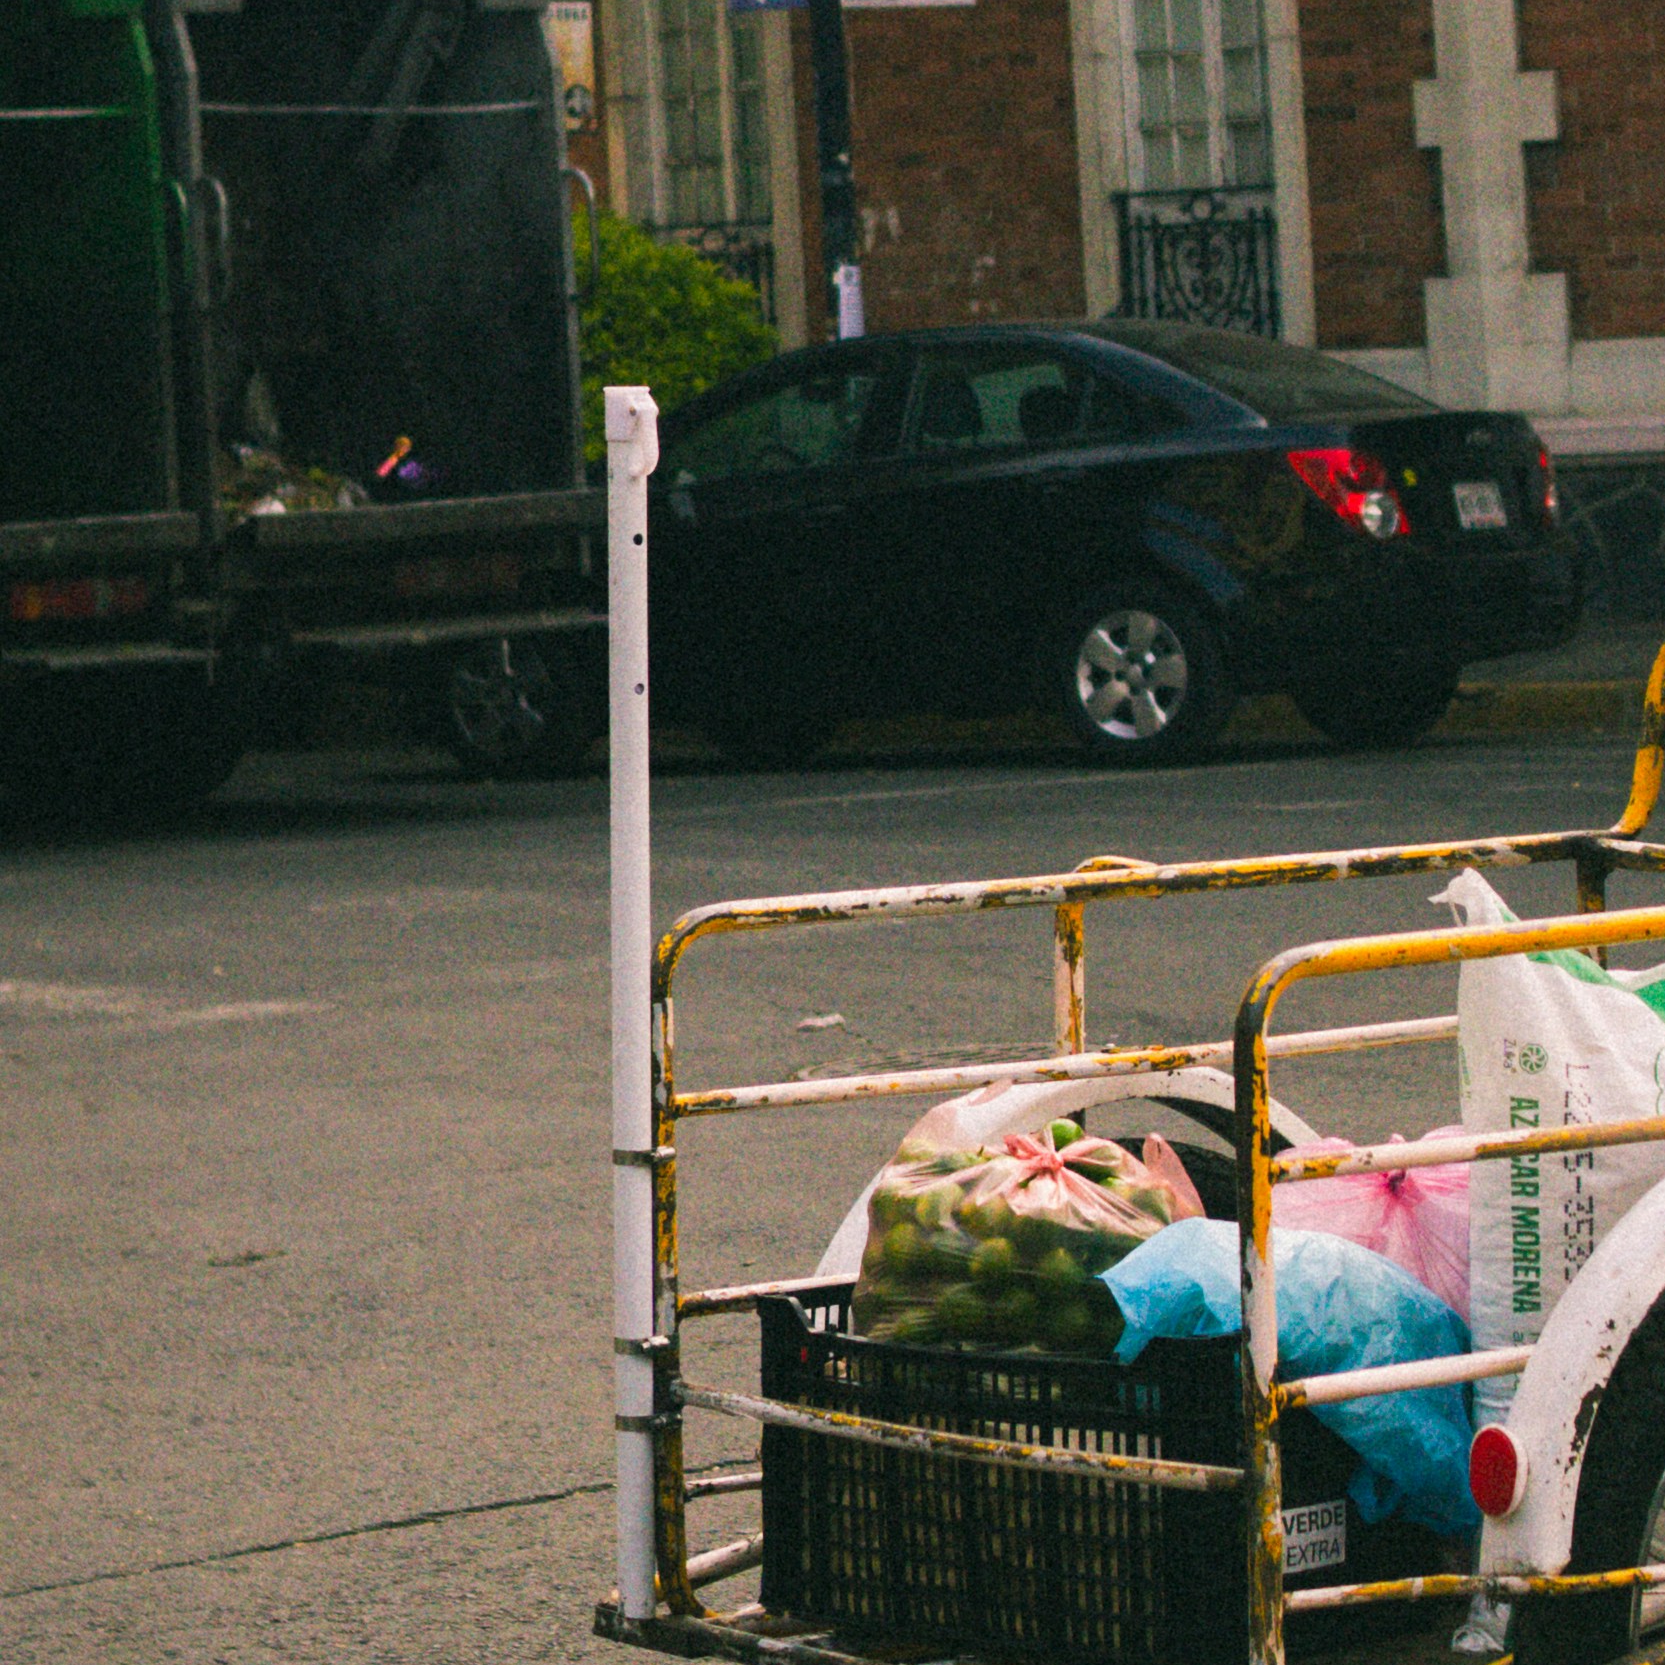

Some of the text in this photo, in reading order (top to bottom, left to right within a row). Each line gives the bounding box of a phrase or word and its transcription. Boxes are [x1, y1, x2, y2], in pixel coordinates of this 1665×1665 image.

[1509, 1095, 1542, 1314] AZCAR MORENA
[1282, 1505, 1344, 1535] VERDE
[1286, 1538, 1341, 1567] EXTRA
